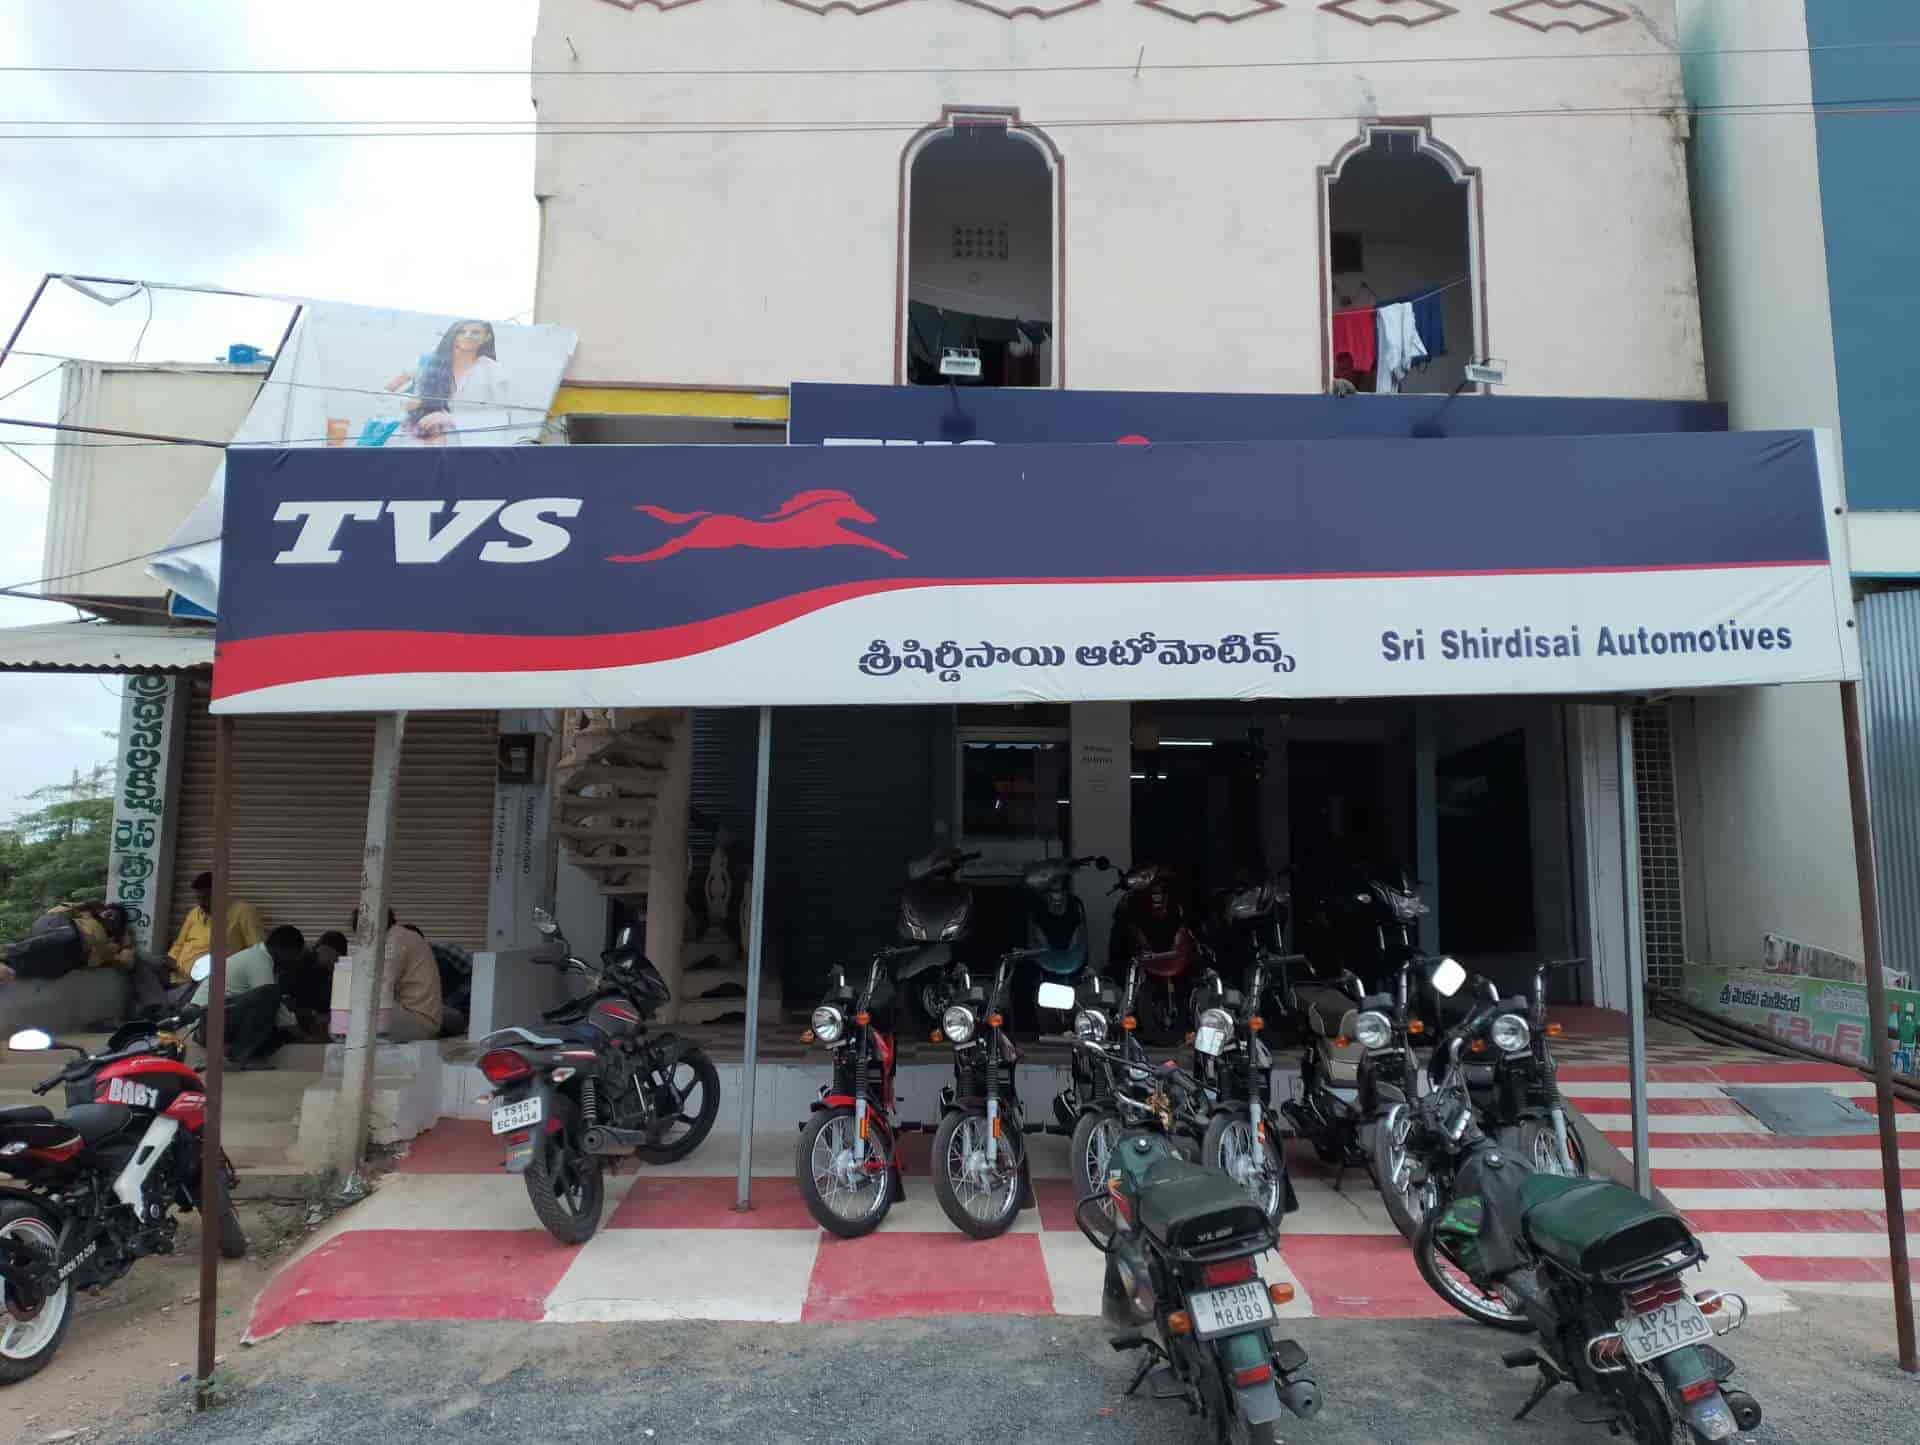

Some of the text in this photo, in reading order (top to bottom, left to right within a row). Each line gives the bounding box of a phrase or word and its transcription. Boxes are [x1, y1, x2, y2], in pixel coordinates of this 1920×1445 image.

[273, 497, 583, 563] TVS
[1381, 619, 1793, 661] Sri Shirdisai Automotives
[1215, 1302, 1264, 1327] M8489
[1639, 1304, 1679, 1332] AP27
[1639, 1315, 1704, 1353] BZ1790
